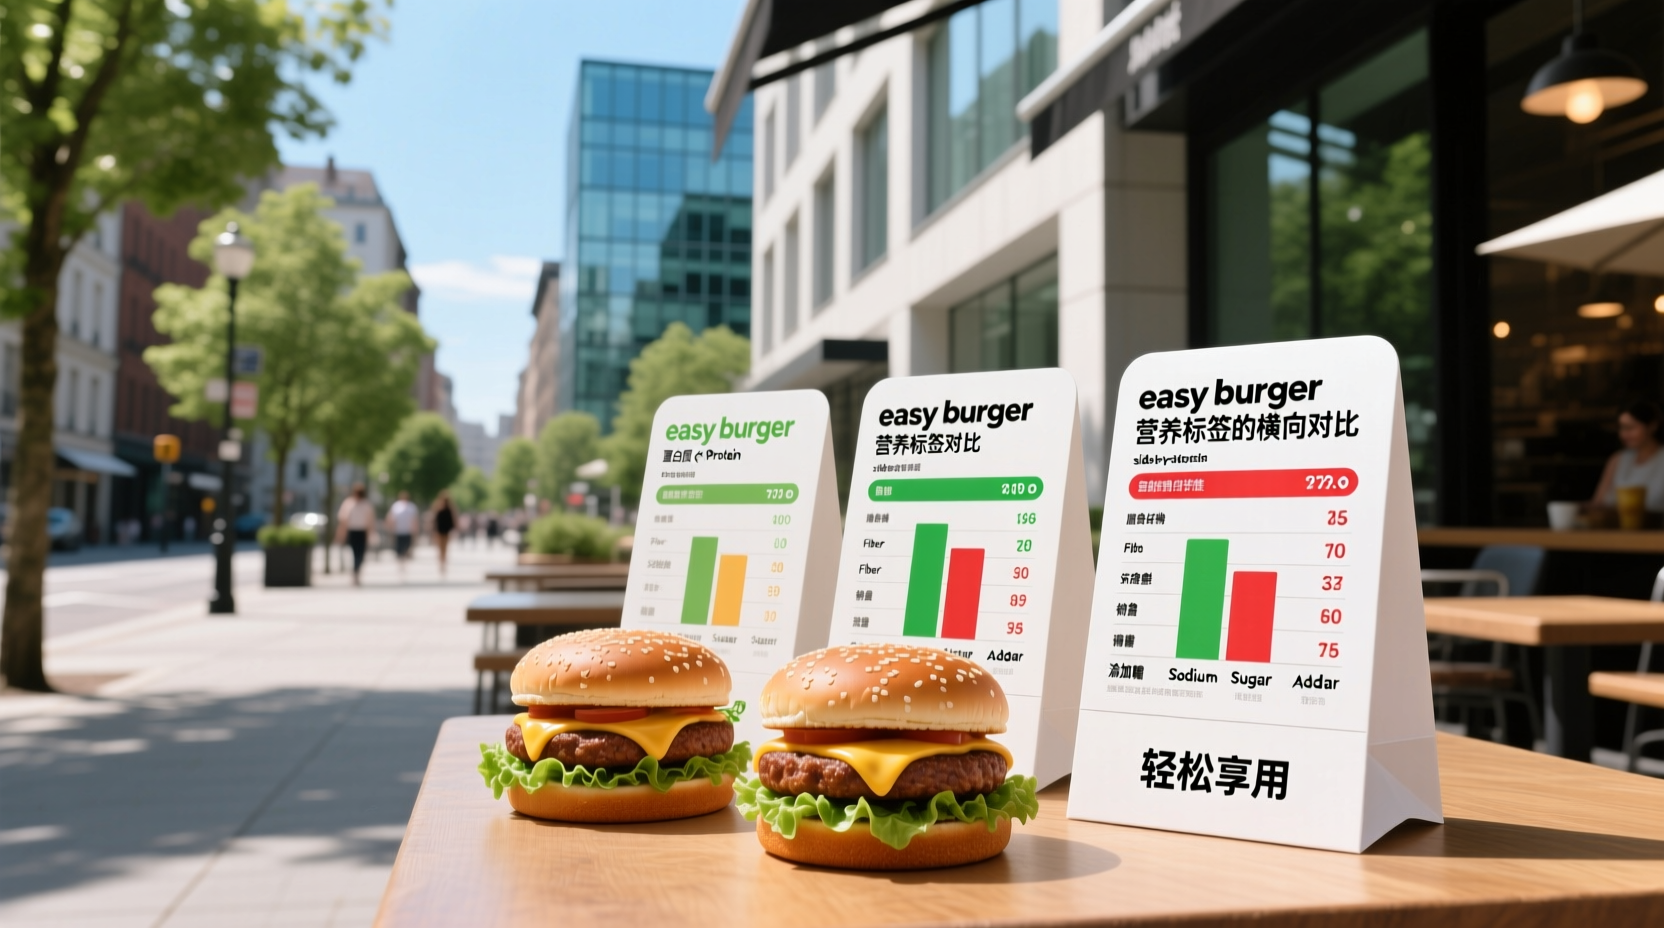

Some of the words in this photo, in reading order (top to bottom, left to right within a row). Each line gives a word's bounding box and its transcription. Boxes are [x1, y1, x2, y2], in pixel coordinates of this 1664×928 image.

[1138, 386, 1209, 414] easy
[1214, 378, 1323, 410] burger
[878, 406, 939, 431] easy
[942, 399, 1034, 429] burger
[1136, 409, 1360, 445] 营养标签的横向对比
[665, 422, 717, 446] easy
[719, 416, 796, 445] burger
[875, 431, 982, 456] 营养标签对比
[1325, 543, 1346, 559] 70
[1320, 608, 1342, 625] 60
[1318, 642, 1339, 658] 75
[1168, 667, 1218, 684] Sodium
[1231, 671, 1273, 689] Sugar
[1140, 747, 1290, 801] 轻松享用
